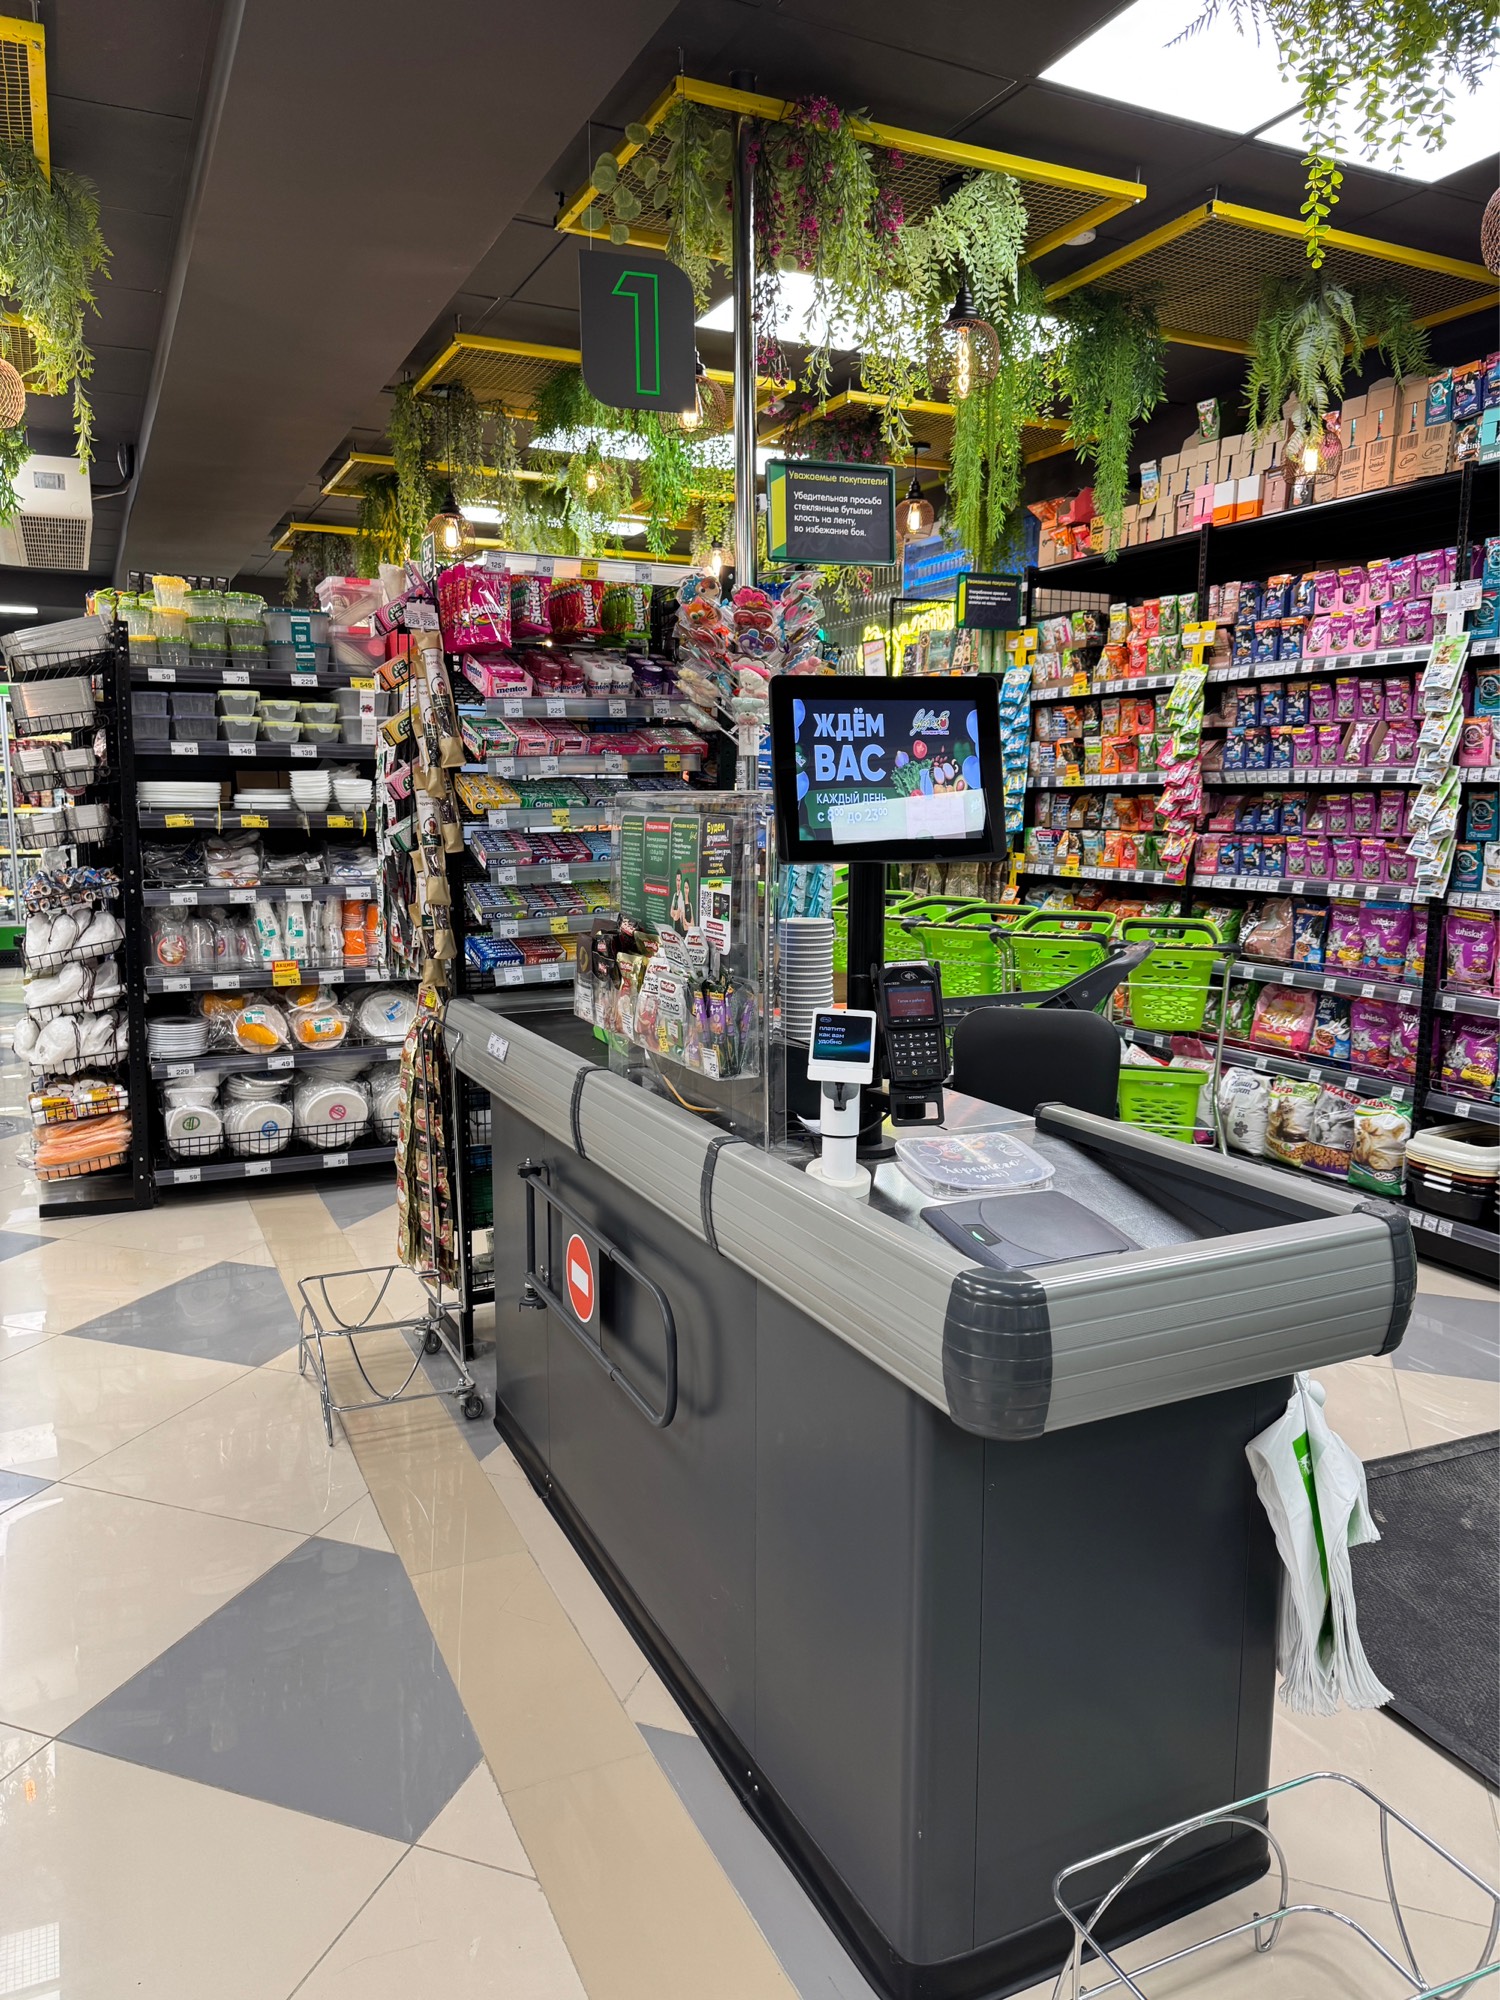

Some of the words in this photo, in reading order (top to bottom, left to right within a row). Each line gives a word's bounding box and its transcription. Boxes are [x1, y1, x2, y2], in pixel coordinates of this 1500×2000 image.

[612, 271, 660, 395] 1
[789, 470, 837, 482] Уважаемые
[839, 476, 888, 486] покупатели!
[794, 491, 848, 503] Убедительная
[850, 496, 882, 505] просьба
[794, 504, 839, 513] стеклянные
[841, 506, 873, 516] бутылки
[821, 516, 832, 524] на
[833, 518, 856, 526] ленту,
[805, 525, 848, 536] избежание
[850, 528, 867, 536] боя.
[583, 584, 596, 627] Skittles
[634, 587, 646, 631] Skittles
[496, 684, 528, 694] mentos
[813, 708, 884, 741] ЖДЁМ
[814, 744, 886, 782] ВАС
[535, 800, 554, 808] Orbit
[816, 792, 860, 805] КАЖДЫЙ
[862, 793, 887, 804] ДЕНЬ
[817, 812, 824, 822] с
[846, 810, 862, 824] до
[706, 822, 726, 834] Будем
[1455, 928, 1484, 940] whiskas
[496, 958, 520, 966] HALLS
[1461, 1024, 1498, 1035] whiskas
